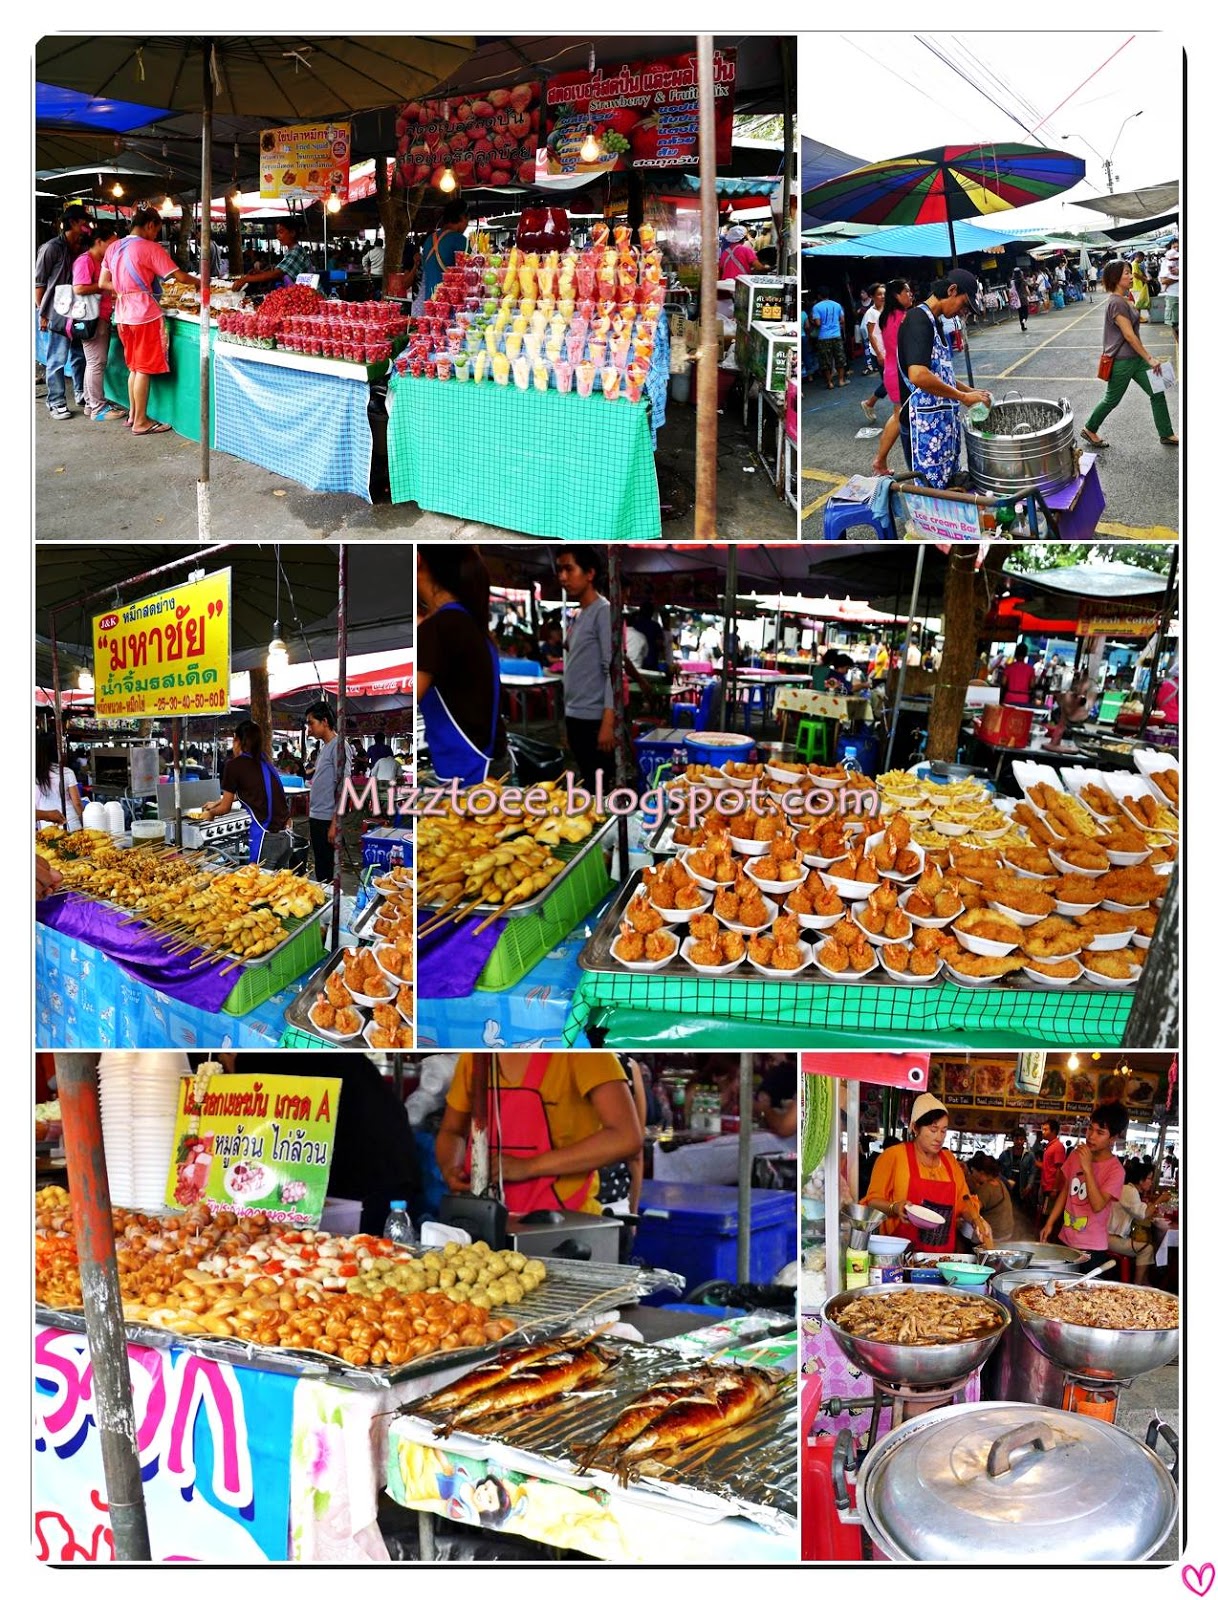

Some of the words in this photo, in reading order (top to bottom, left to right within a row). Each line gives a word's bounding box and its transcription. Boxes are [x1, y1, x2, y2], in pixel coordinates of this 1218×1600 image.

[589, 91, 652, 113] Strawberry
[654, 89, 666, 104] &
[668, 85, 701, 103] Fruit
[914, 510, 928, 521] Ice
[929, 516, 958, 530] cream
[960, 522, 977, 534] Bar
[100, 615, 117, 629] J&K
[122, 597, 175, 624] หมึกสดย่าง
[101, 662, 218, 696] น้ำจิ้มรสเด็ด
[274, 1093, 312, 1122] เกรด
[314, 1089, 331, 1123] A
[215, 1124, 264, 1169] หมูล้วน
[273, 1123, 327, 1165] ไก่ล้วน
